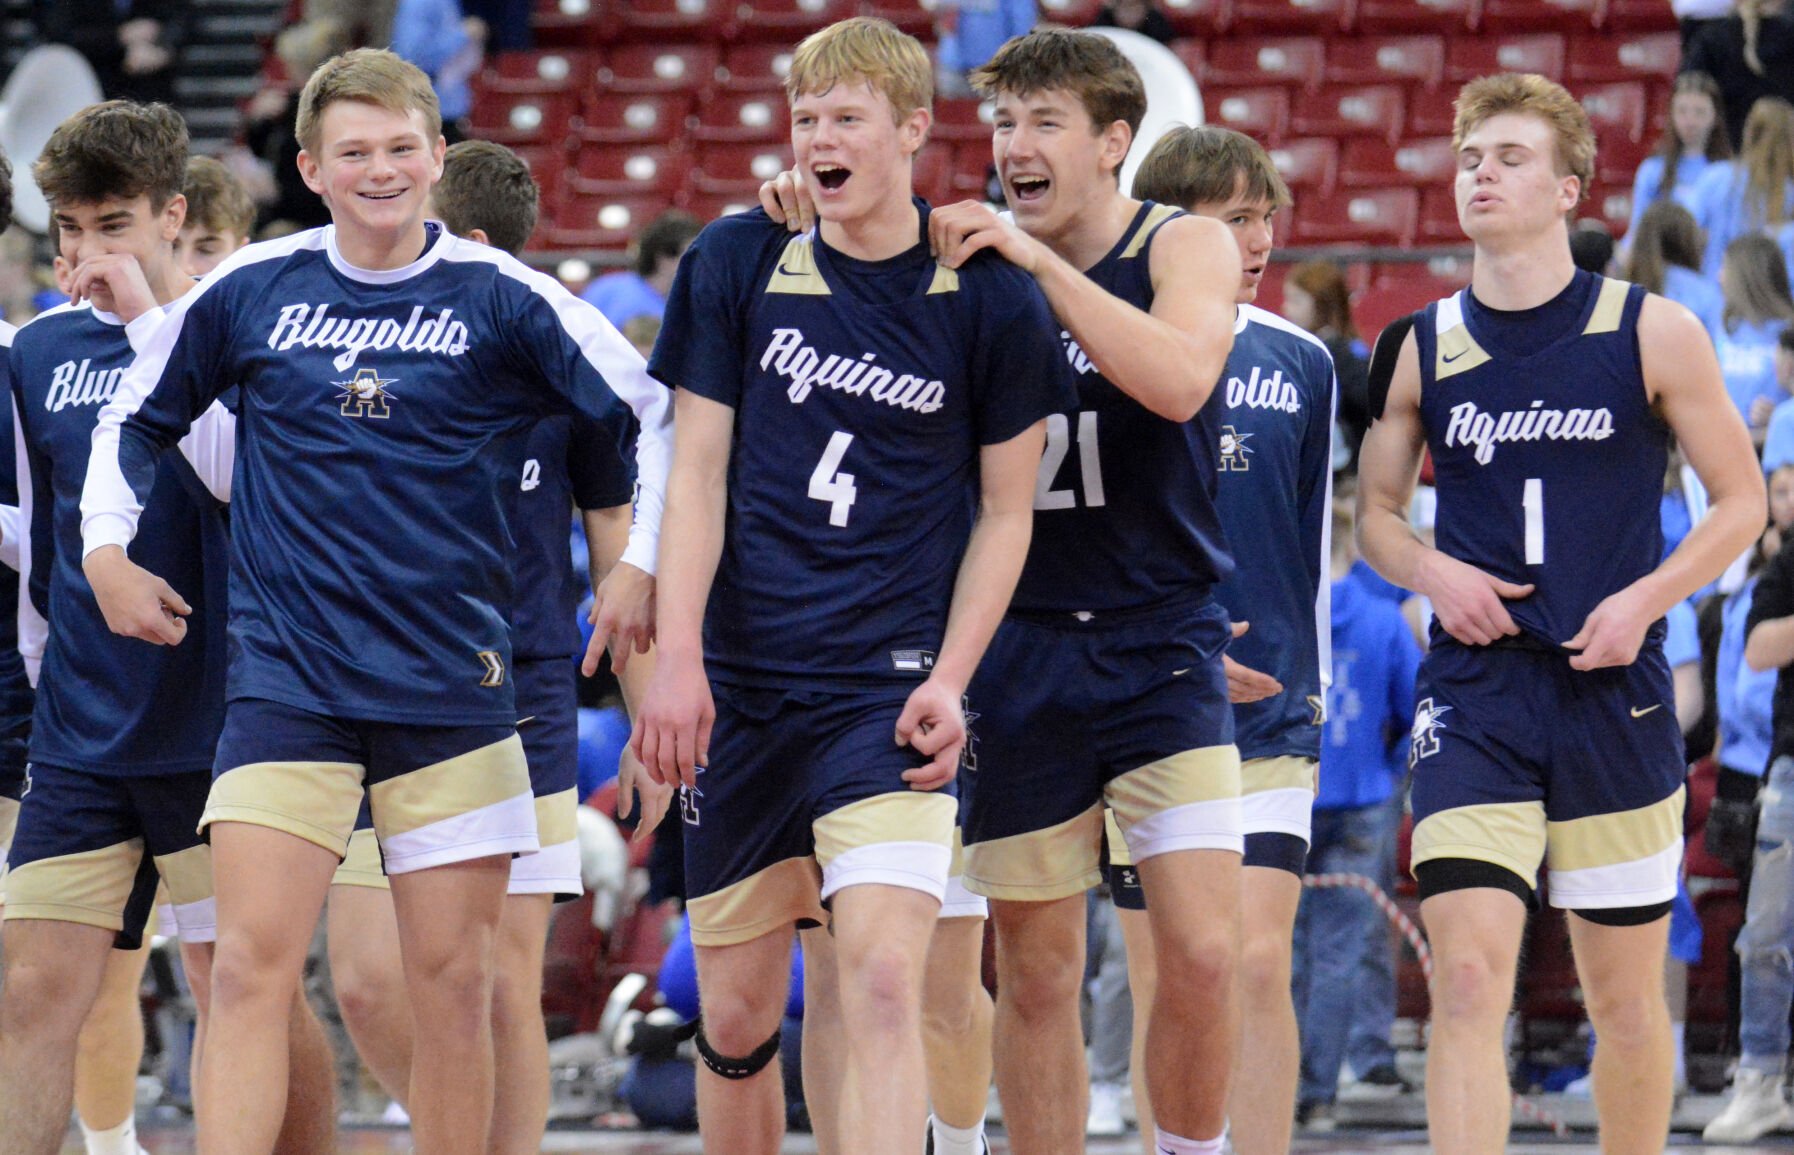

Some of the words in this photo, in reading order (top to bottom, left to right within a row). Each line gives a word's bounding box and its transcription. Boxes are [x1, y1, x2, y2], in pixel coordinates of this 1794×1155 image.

[266, 302, 471, 373] Blugolds
[760, 327, 947, 415] Aquinas
[1033, 411, 1106, 511] 21
[1444, 399, 1615, 467] Aquinas
[807, 430, 858, 528] 4
[1521, 478, 1545, 566] 1
